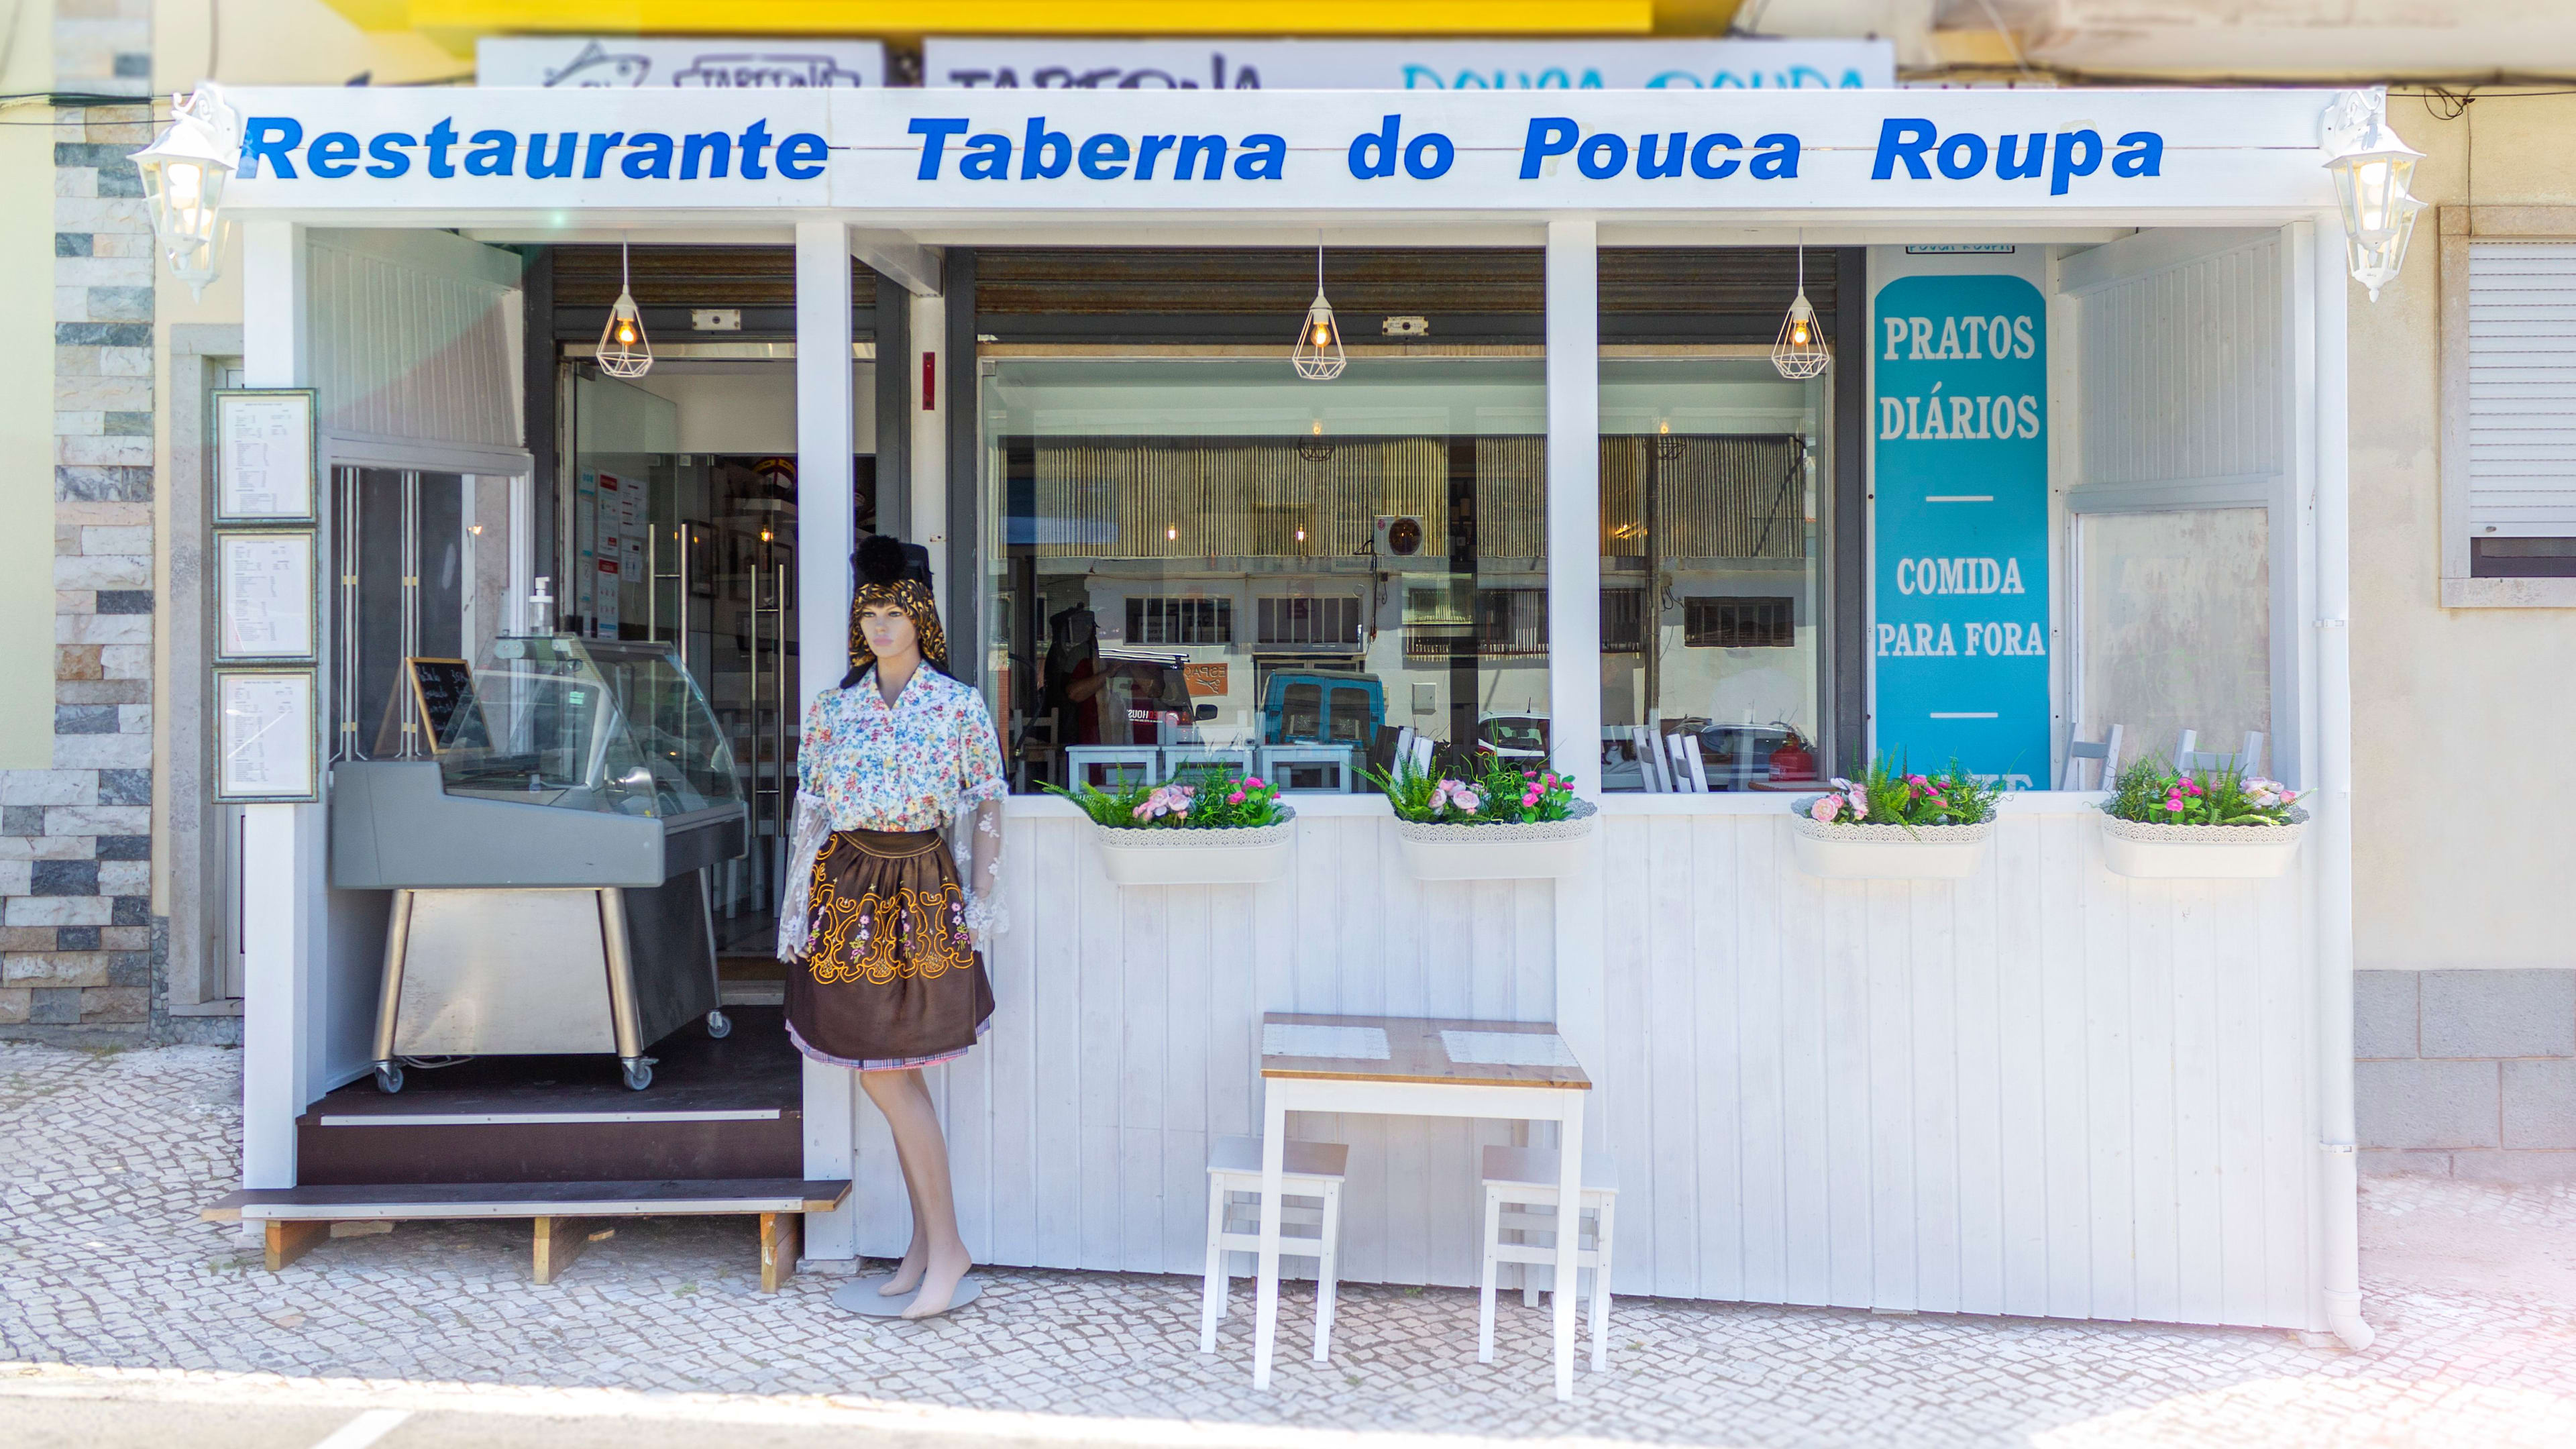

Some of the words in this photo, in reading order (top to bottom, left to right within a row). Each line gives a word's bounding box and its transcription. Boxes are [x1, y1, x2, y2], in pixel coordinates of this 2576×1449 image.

[235, 117, 829, 180] Restaurante
[908, 116, 1287, 180] Taberna
[1348, 113, 1455, 180] do
[1519, 117, 1801, 180] Pouca
[1871, 117, 2163, 196] Roupa
[1883, 315, 2035, 360] PRATOS
[1880, 380, 2040, 440] DIÁRIOS
[1896, 557, 2025, 595] COMIDA
[1877, 623, 1957, 656] PARA
[1964, 622, 2046, 656] FORA
